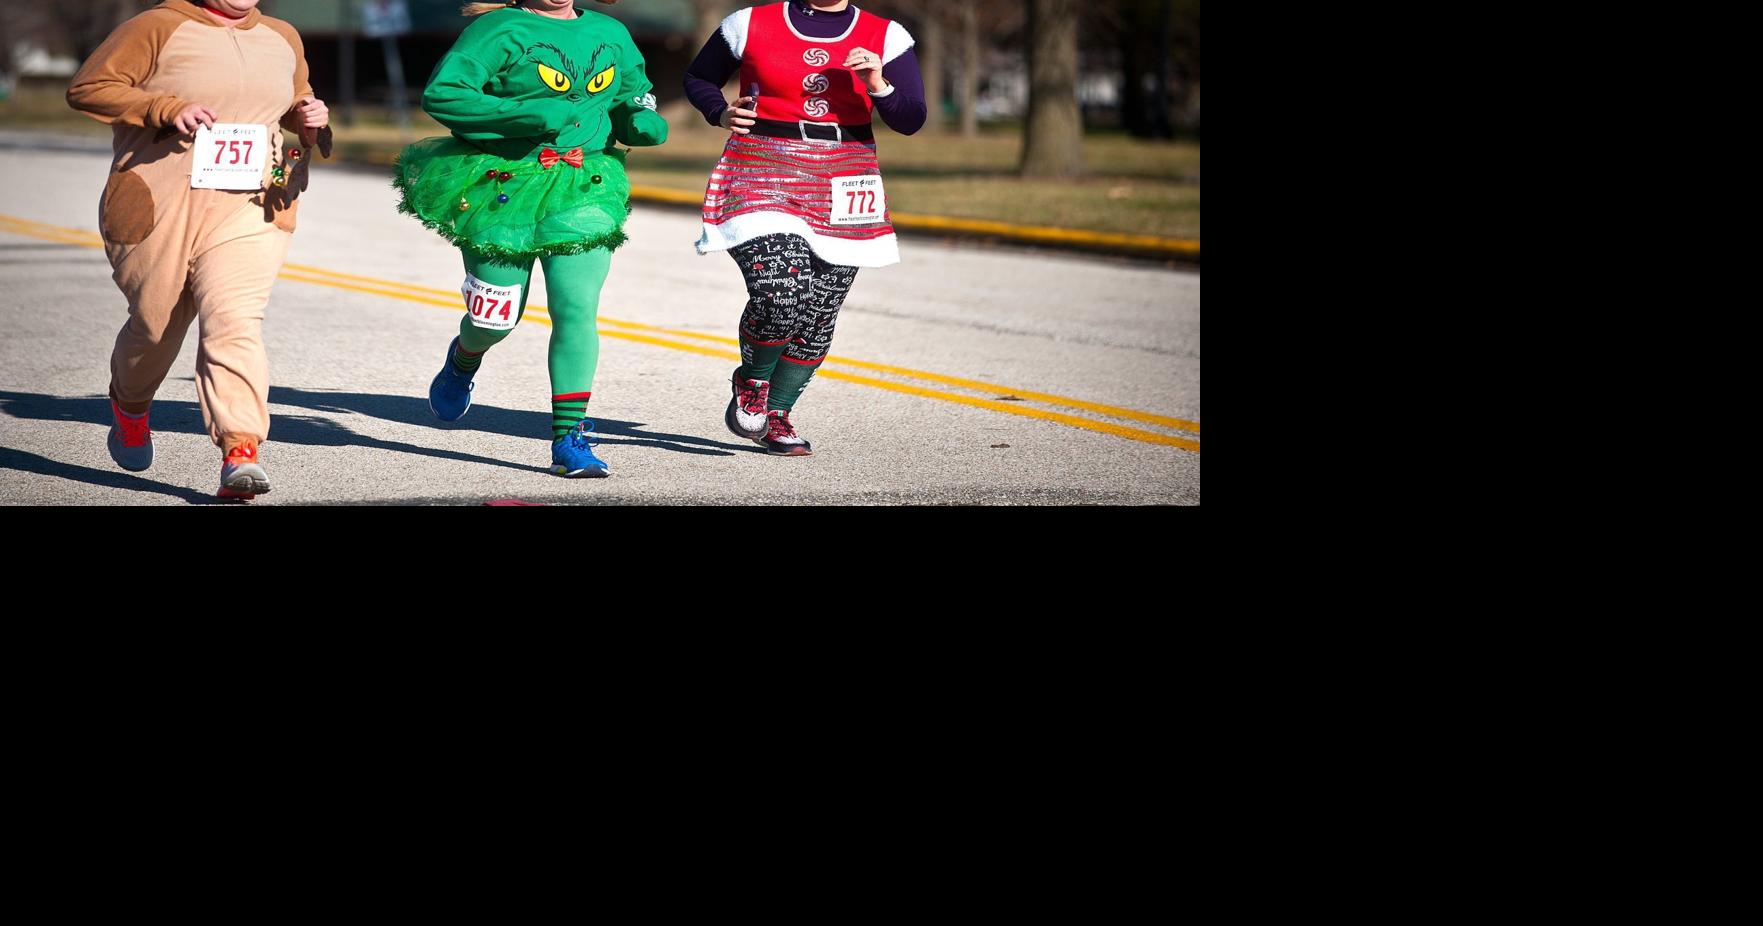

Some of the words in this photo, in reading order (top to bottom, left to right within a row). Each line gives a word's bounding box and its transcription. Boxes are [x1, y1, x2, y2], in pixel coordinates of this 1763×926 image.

[214, 140, 254, 165] 757
[846, 190, 876, 215] 772
[465, 290, 512, 321] 1074
